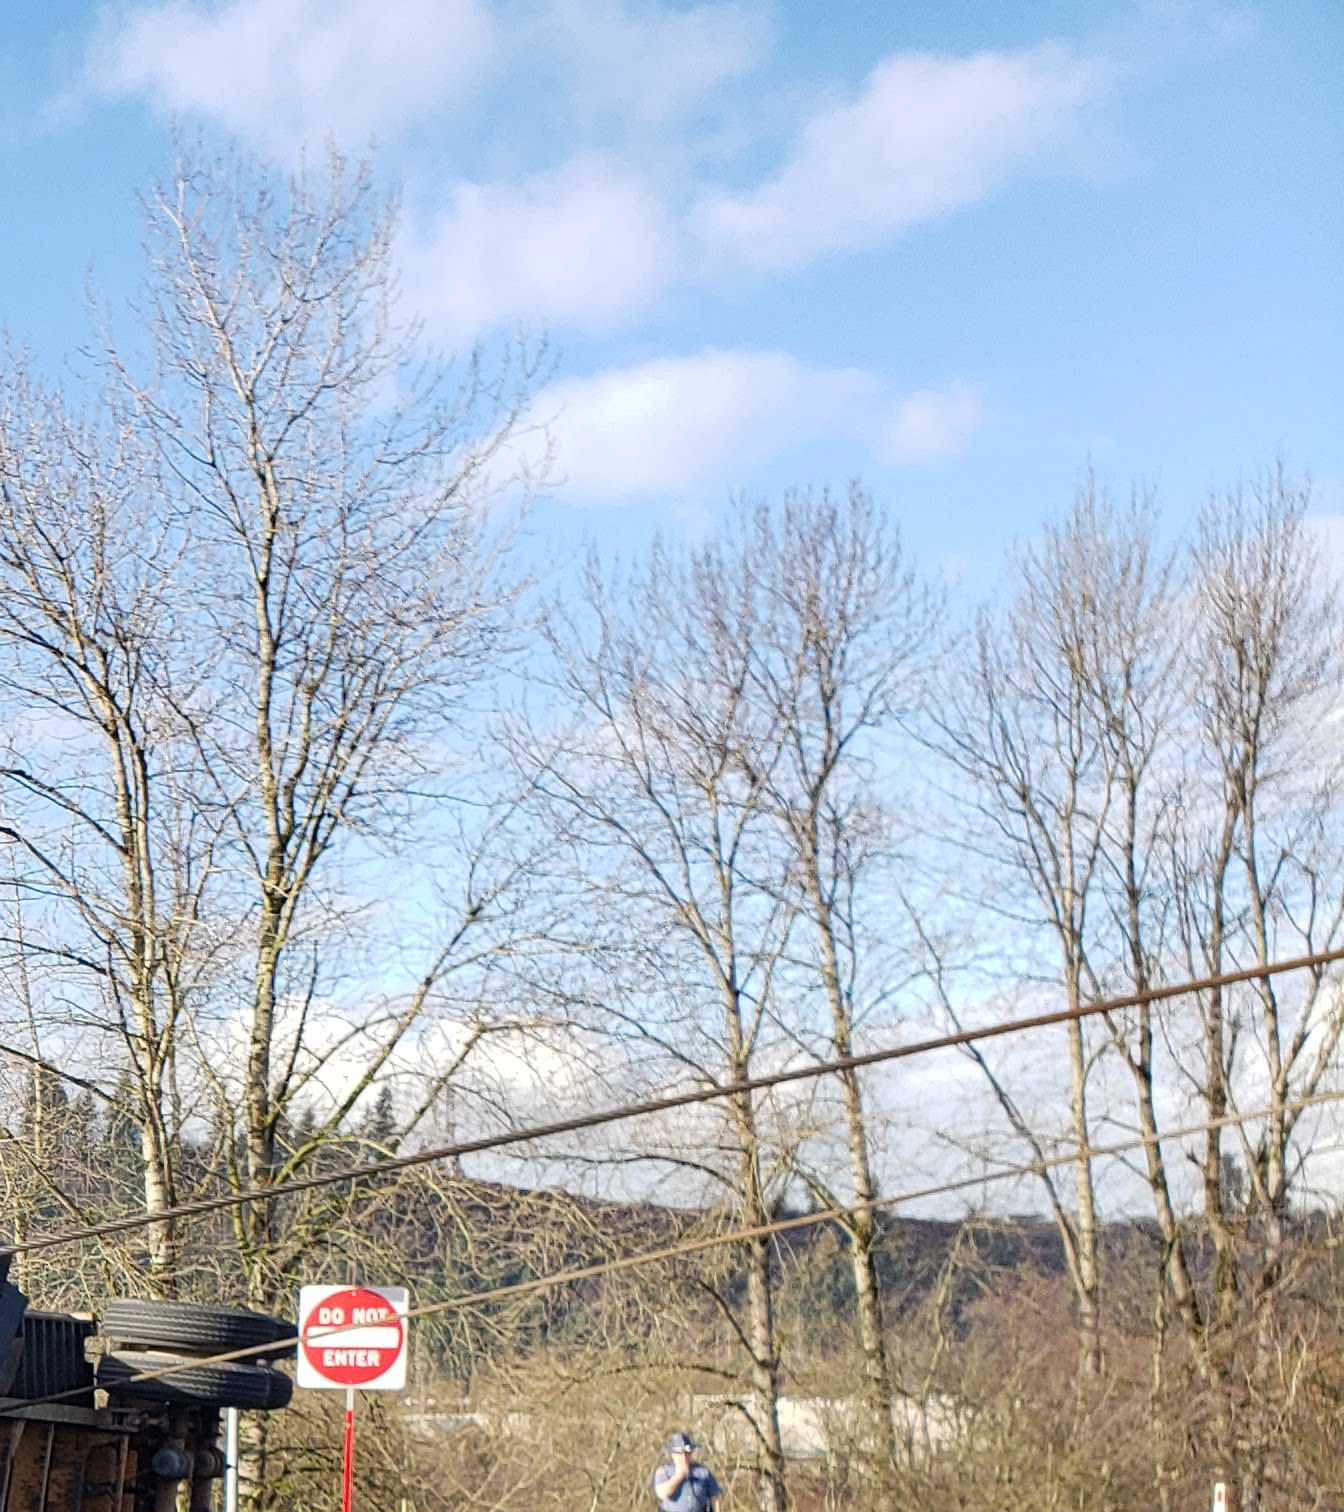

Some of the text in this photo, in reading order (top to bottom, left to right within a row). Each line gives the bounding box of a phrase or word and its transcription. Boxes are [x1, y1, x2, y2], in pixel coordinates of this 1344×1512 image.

[318, 1307, 389, 1325] DO NOT
[323, 1350, 381, 1367] ENTER
